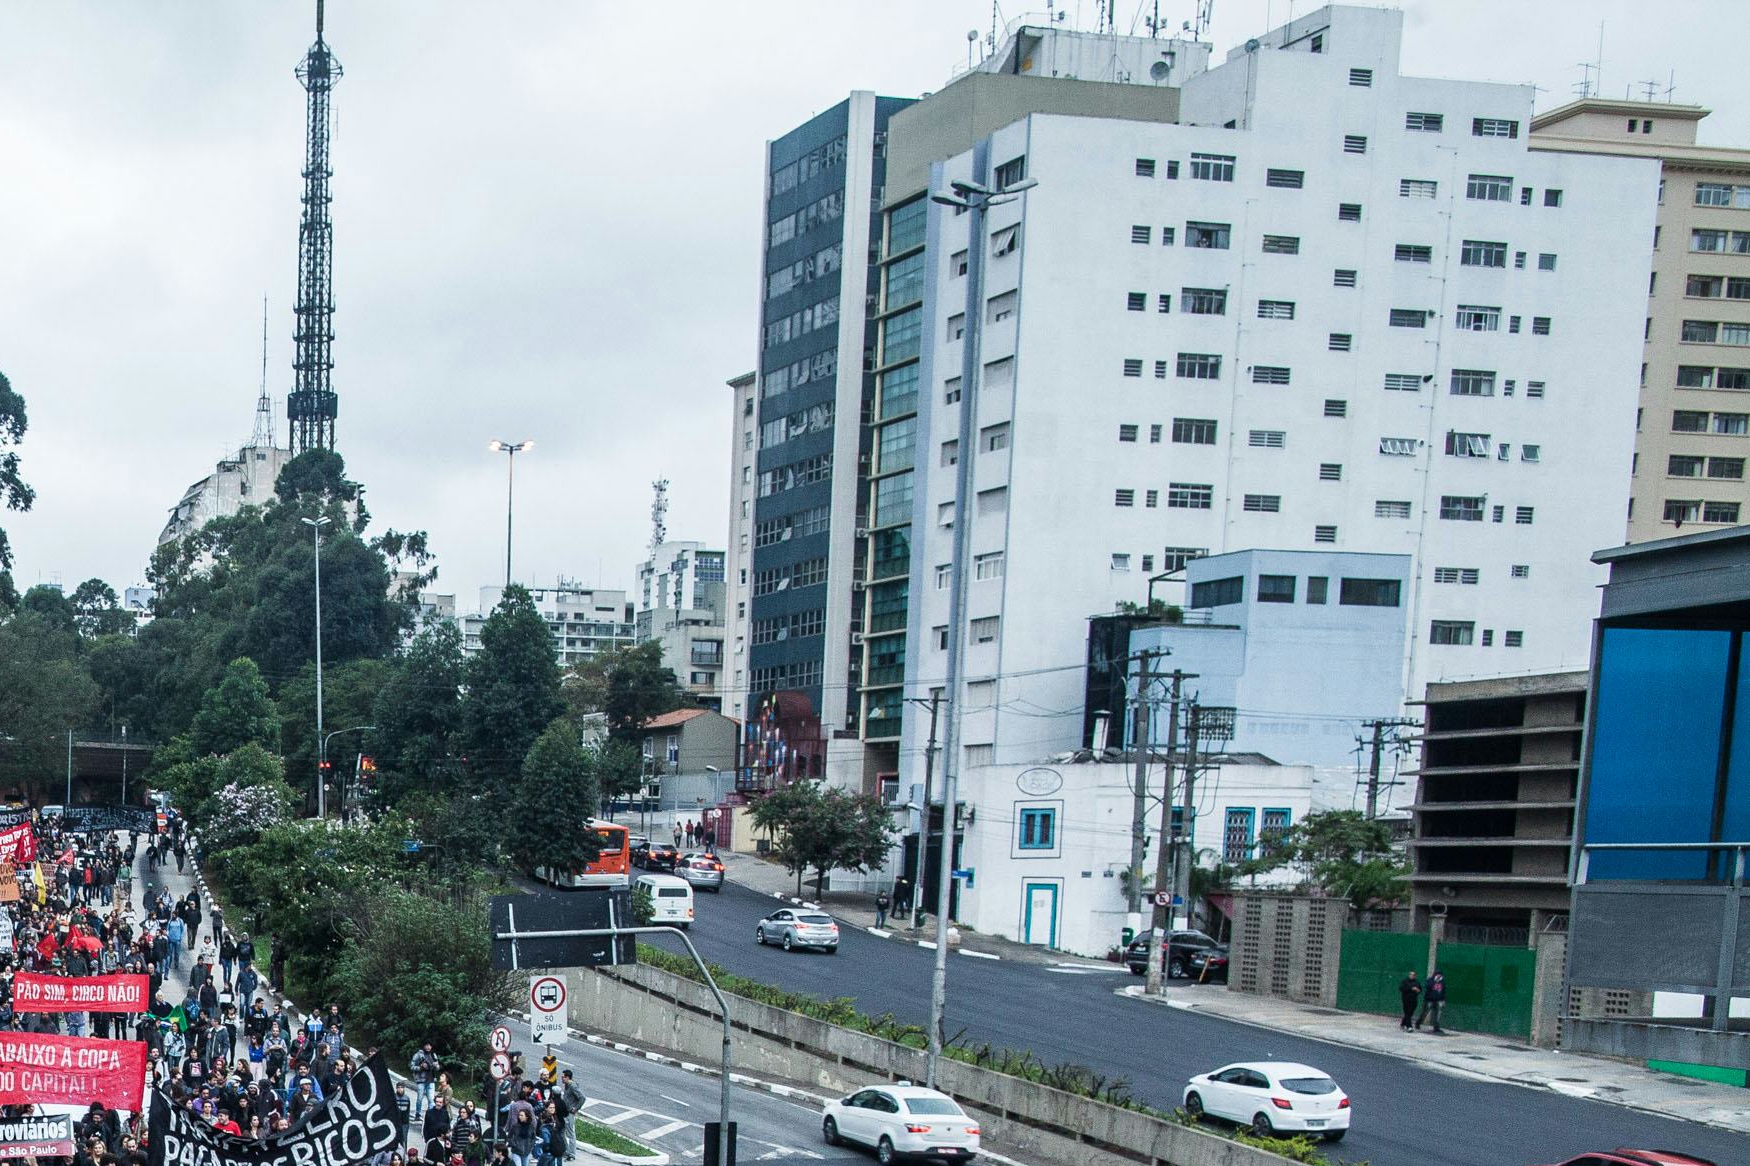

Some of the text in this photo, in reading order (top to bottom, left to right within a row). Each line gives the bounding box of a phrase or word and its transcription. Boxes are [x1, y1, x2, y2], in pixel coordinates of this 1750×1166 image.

[16, 980, 140, 1004] PÃO SIM, CIRCO NÃO!
[536, 1023, 563, 1032] ÔNIBUS
[60, 1047, 72, 1068] A
[77, 1048, 121, 1071] COPA
[7, 1145, 28, 1157] São
[29, 1145, 58, 1156] Paulo
